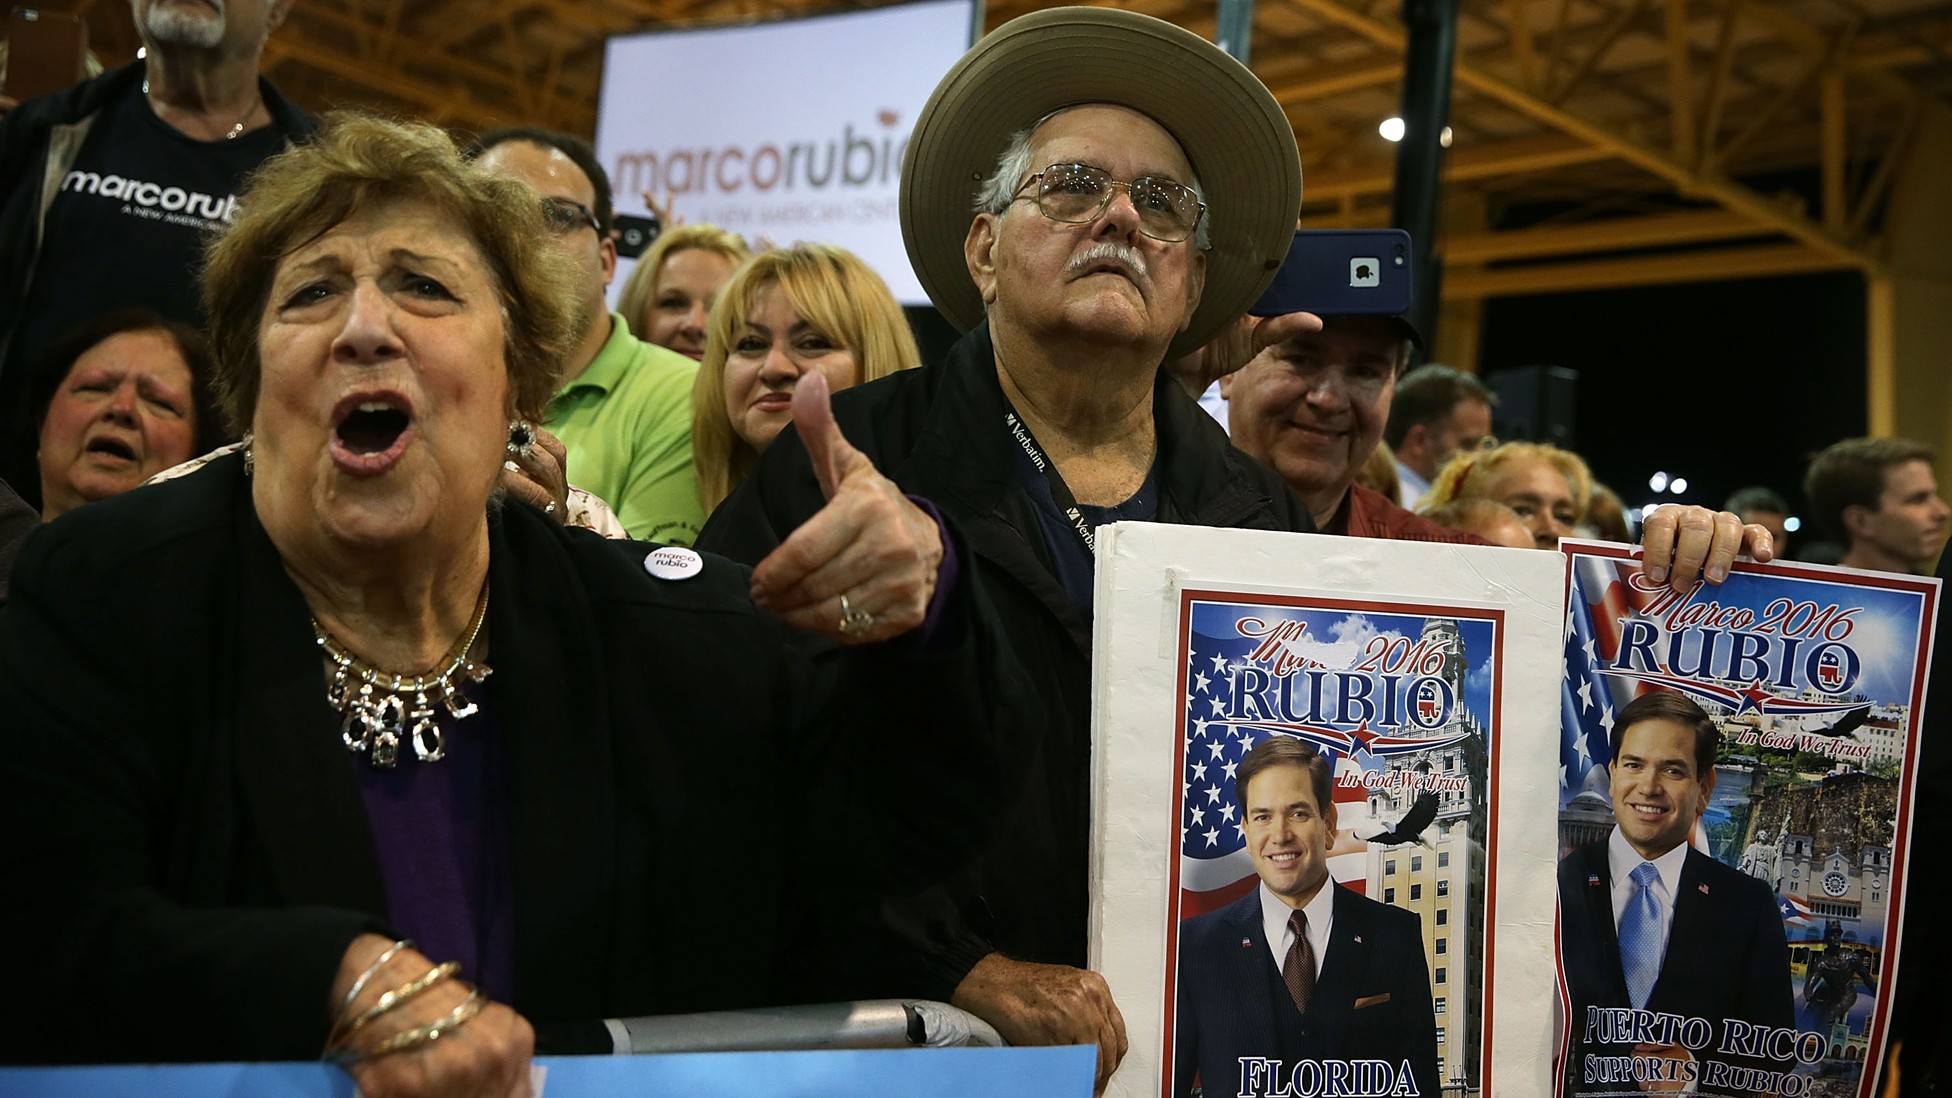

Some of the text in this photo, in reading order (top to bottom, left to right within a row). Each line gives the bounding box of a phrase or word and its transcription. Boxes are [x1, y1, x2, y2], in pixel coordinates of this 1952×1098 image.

[613, 107, 904, 196] marcorubi
[654, 552, 696, 562] marco
[656, 559, 688, 568] rubio
[1628, 572, 1864, 642] Marco 2016
[1355, 636, 1452, 676] 2016
[1610, 618, 1861, 696] RUBIO
[1225, 665, 1455, 730] RUBIO
[1736, 728, 1872, 759] In God We Trust
[1338, 769, 1470, 793] In God We Trust
[1583, 1005, 1827, 1065] PUERTO RICO
[1237, 1056, 1420, 1098] FLORIDA
[1584, 1053, 1814, 1098] SUPPORTS RUBIO!
